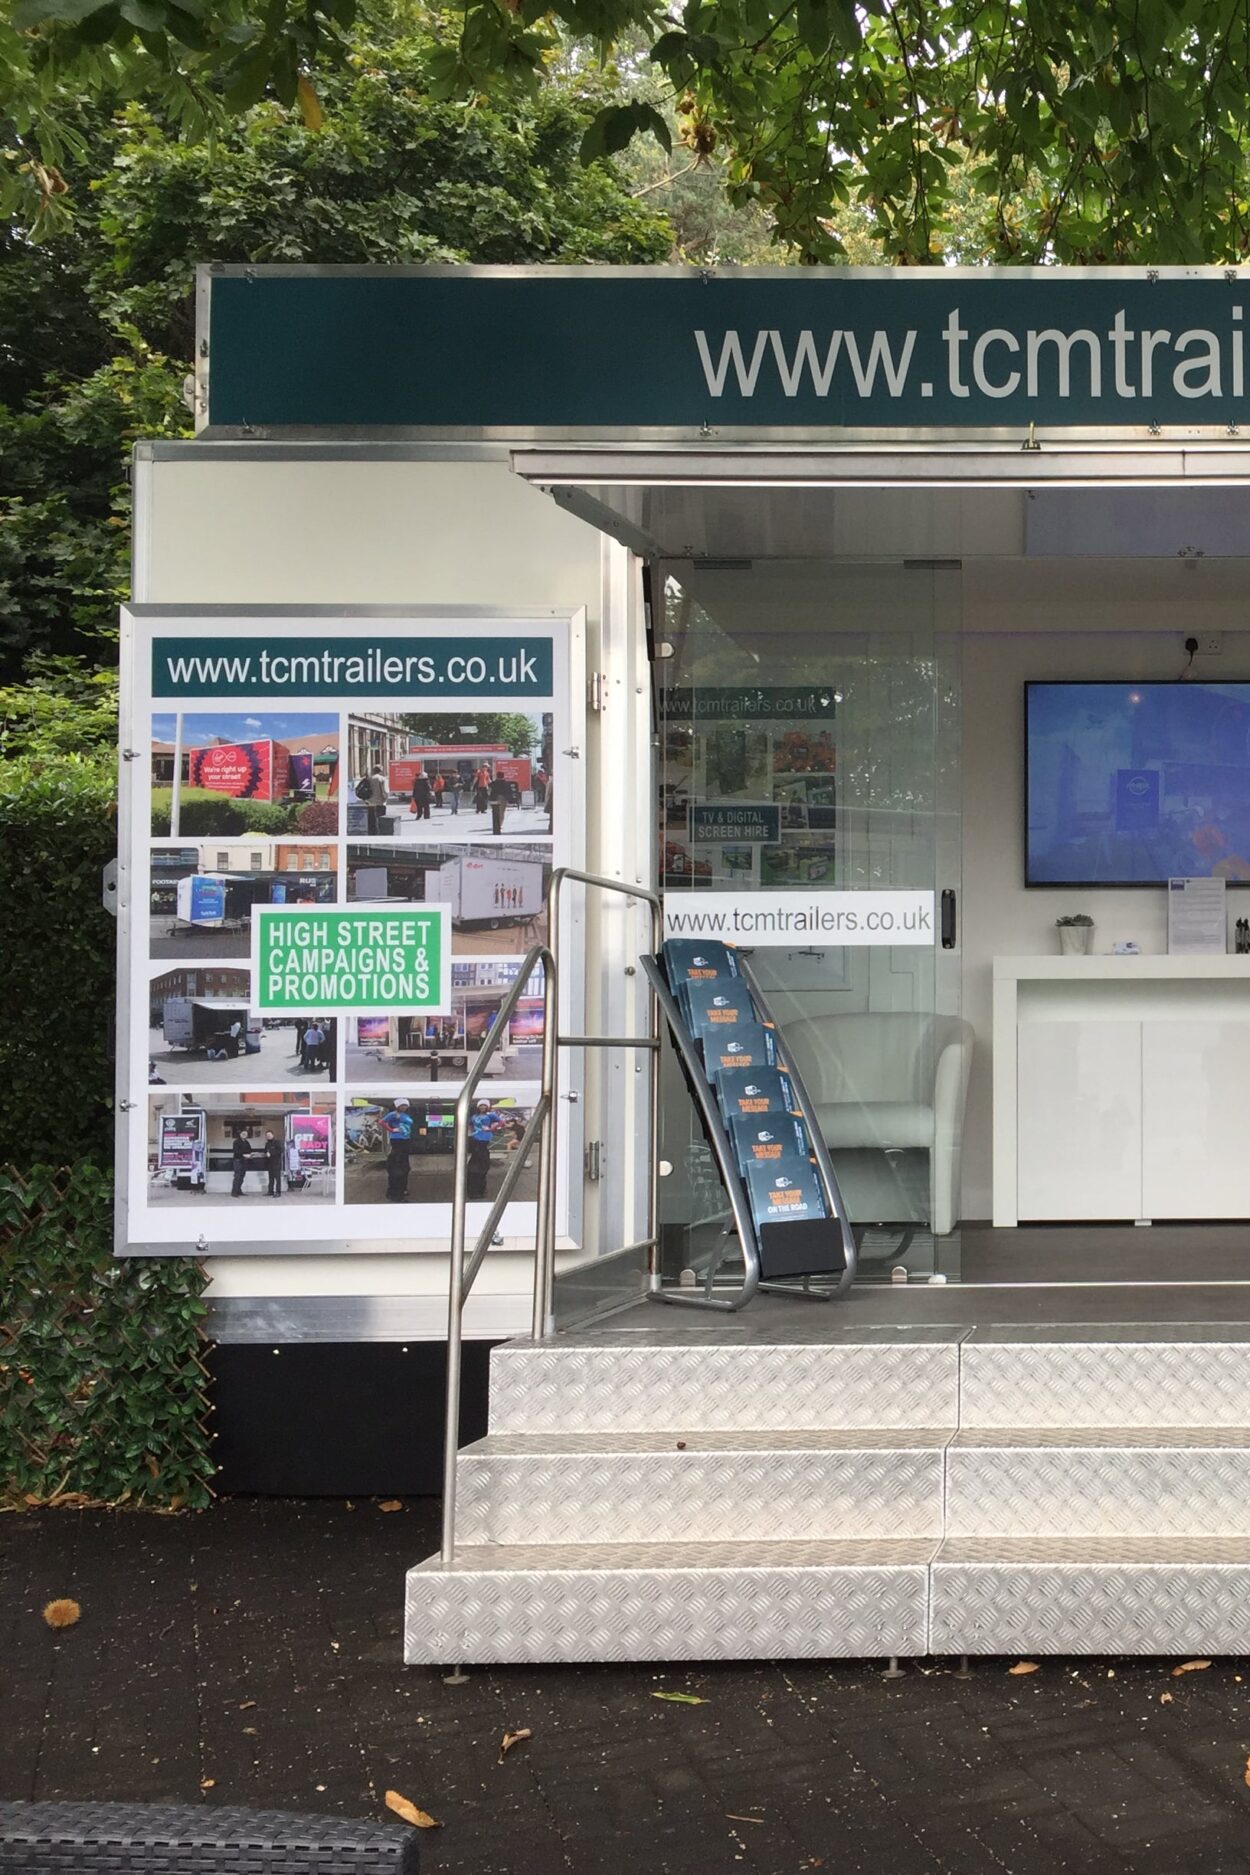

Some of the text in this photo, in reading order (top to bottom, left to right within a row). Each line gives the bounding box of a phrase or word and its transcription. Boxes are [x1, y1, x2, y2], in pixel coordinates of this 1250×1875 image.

[166, 648, 538, 684] www.tcmtrailers.co.uk
[702, 811, 764, 823] TV & DIGITAL
[698, 825, 769, 838] SCREEN HIRE
[667, 905, 931, 932] www.tcmtrailers.co.uk
[269, 921, 432, 946] HIGH STREET
[269, 948, 431, 974] CAMPAIGNS &
[269, 974, 430, 1000] PROMOTIONS
